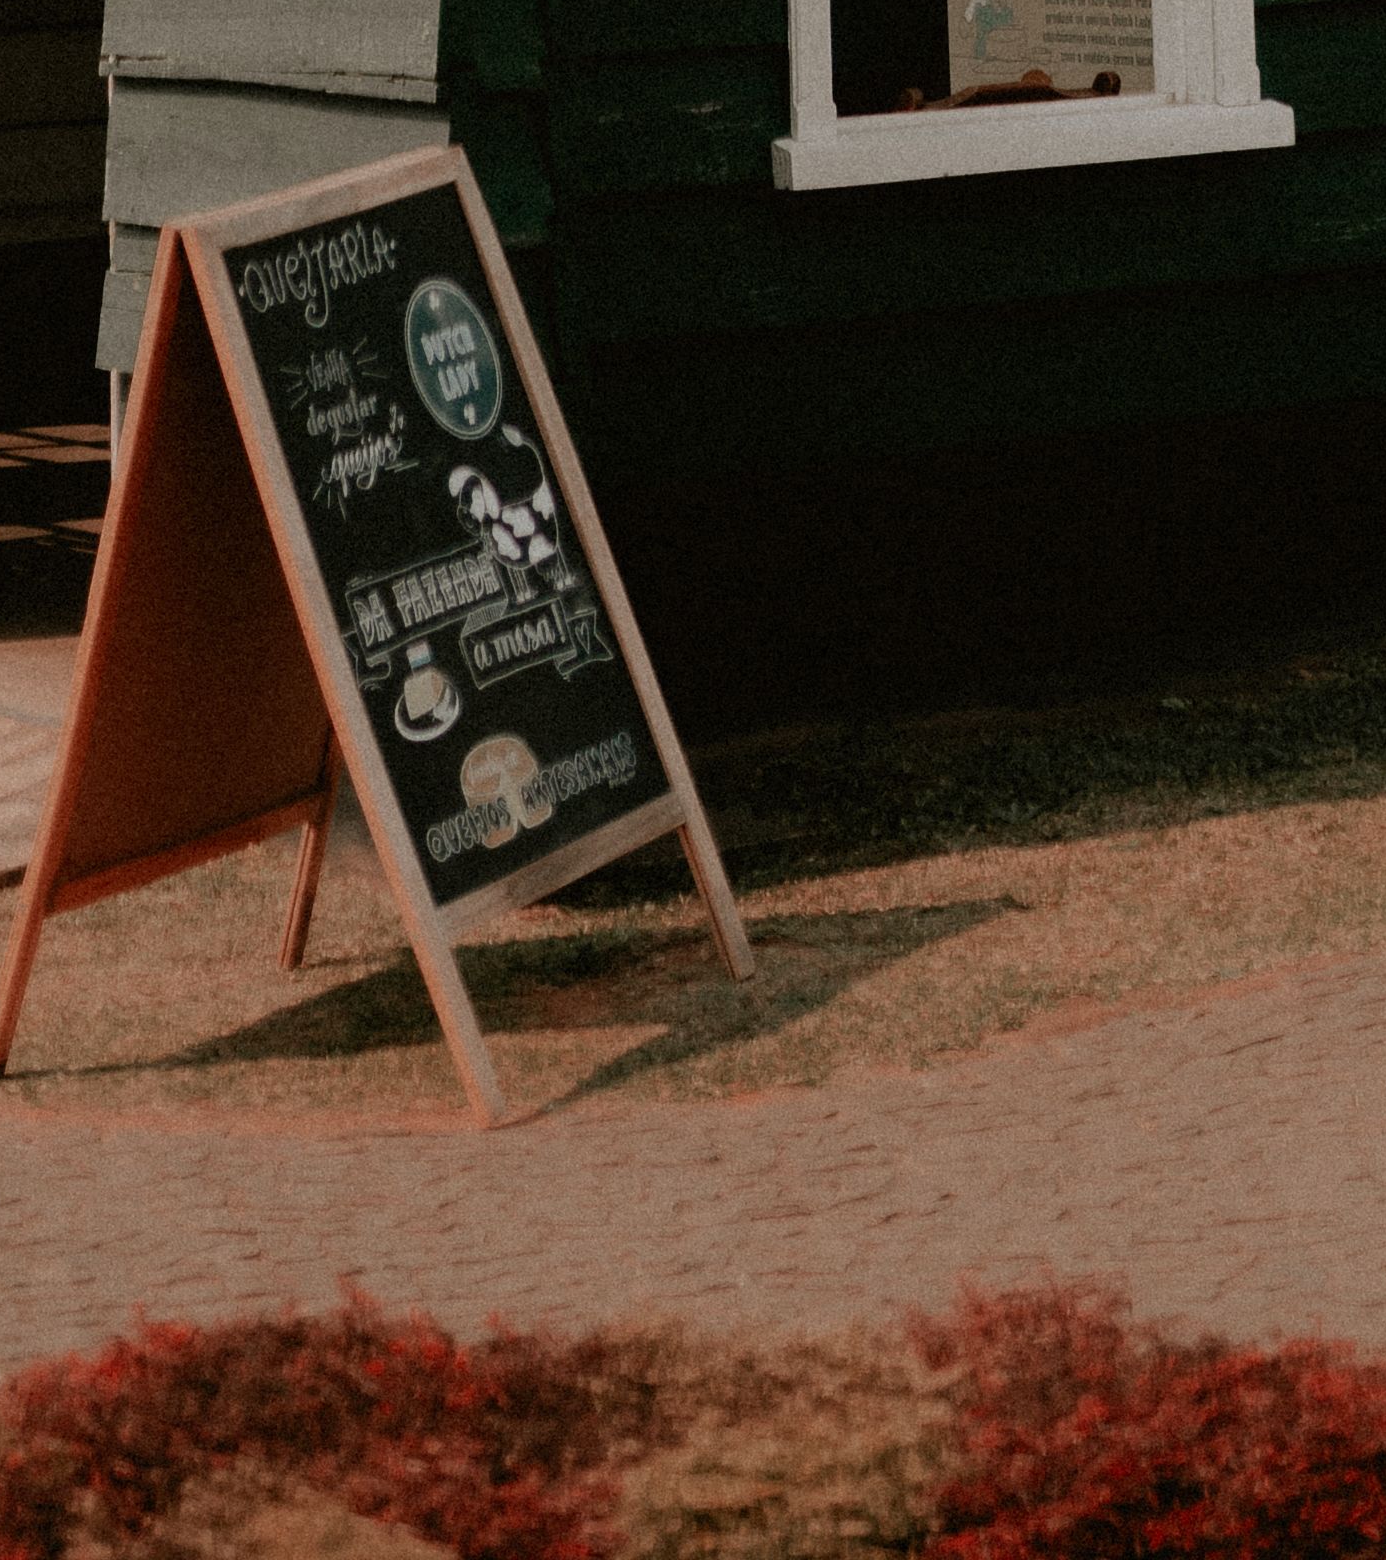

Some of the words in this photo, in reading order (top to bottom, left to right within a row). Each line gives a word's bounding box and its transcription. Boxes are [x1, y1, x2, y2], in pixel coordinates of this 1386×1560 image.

[437, 358, 481, 402] LADY
[306, 387, 376, 445] degustar
[353, 589, 395, 648] DA
[391, 551, 501, 628] FAZENDA
